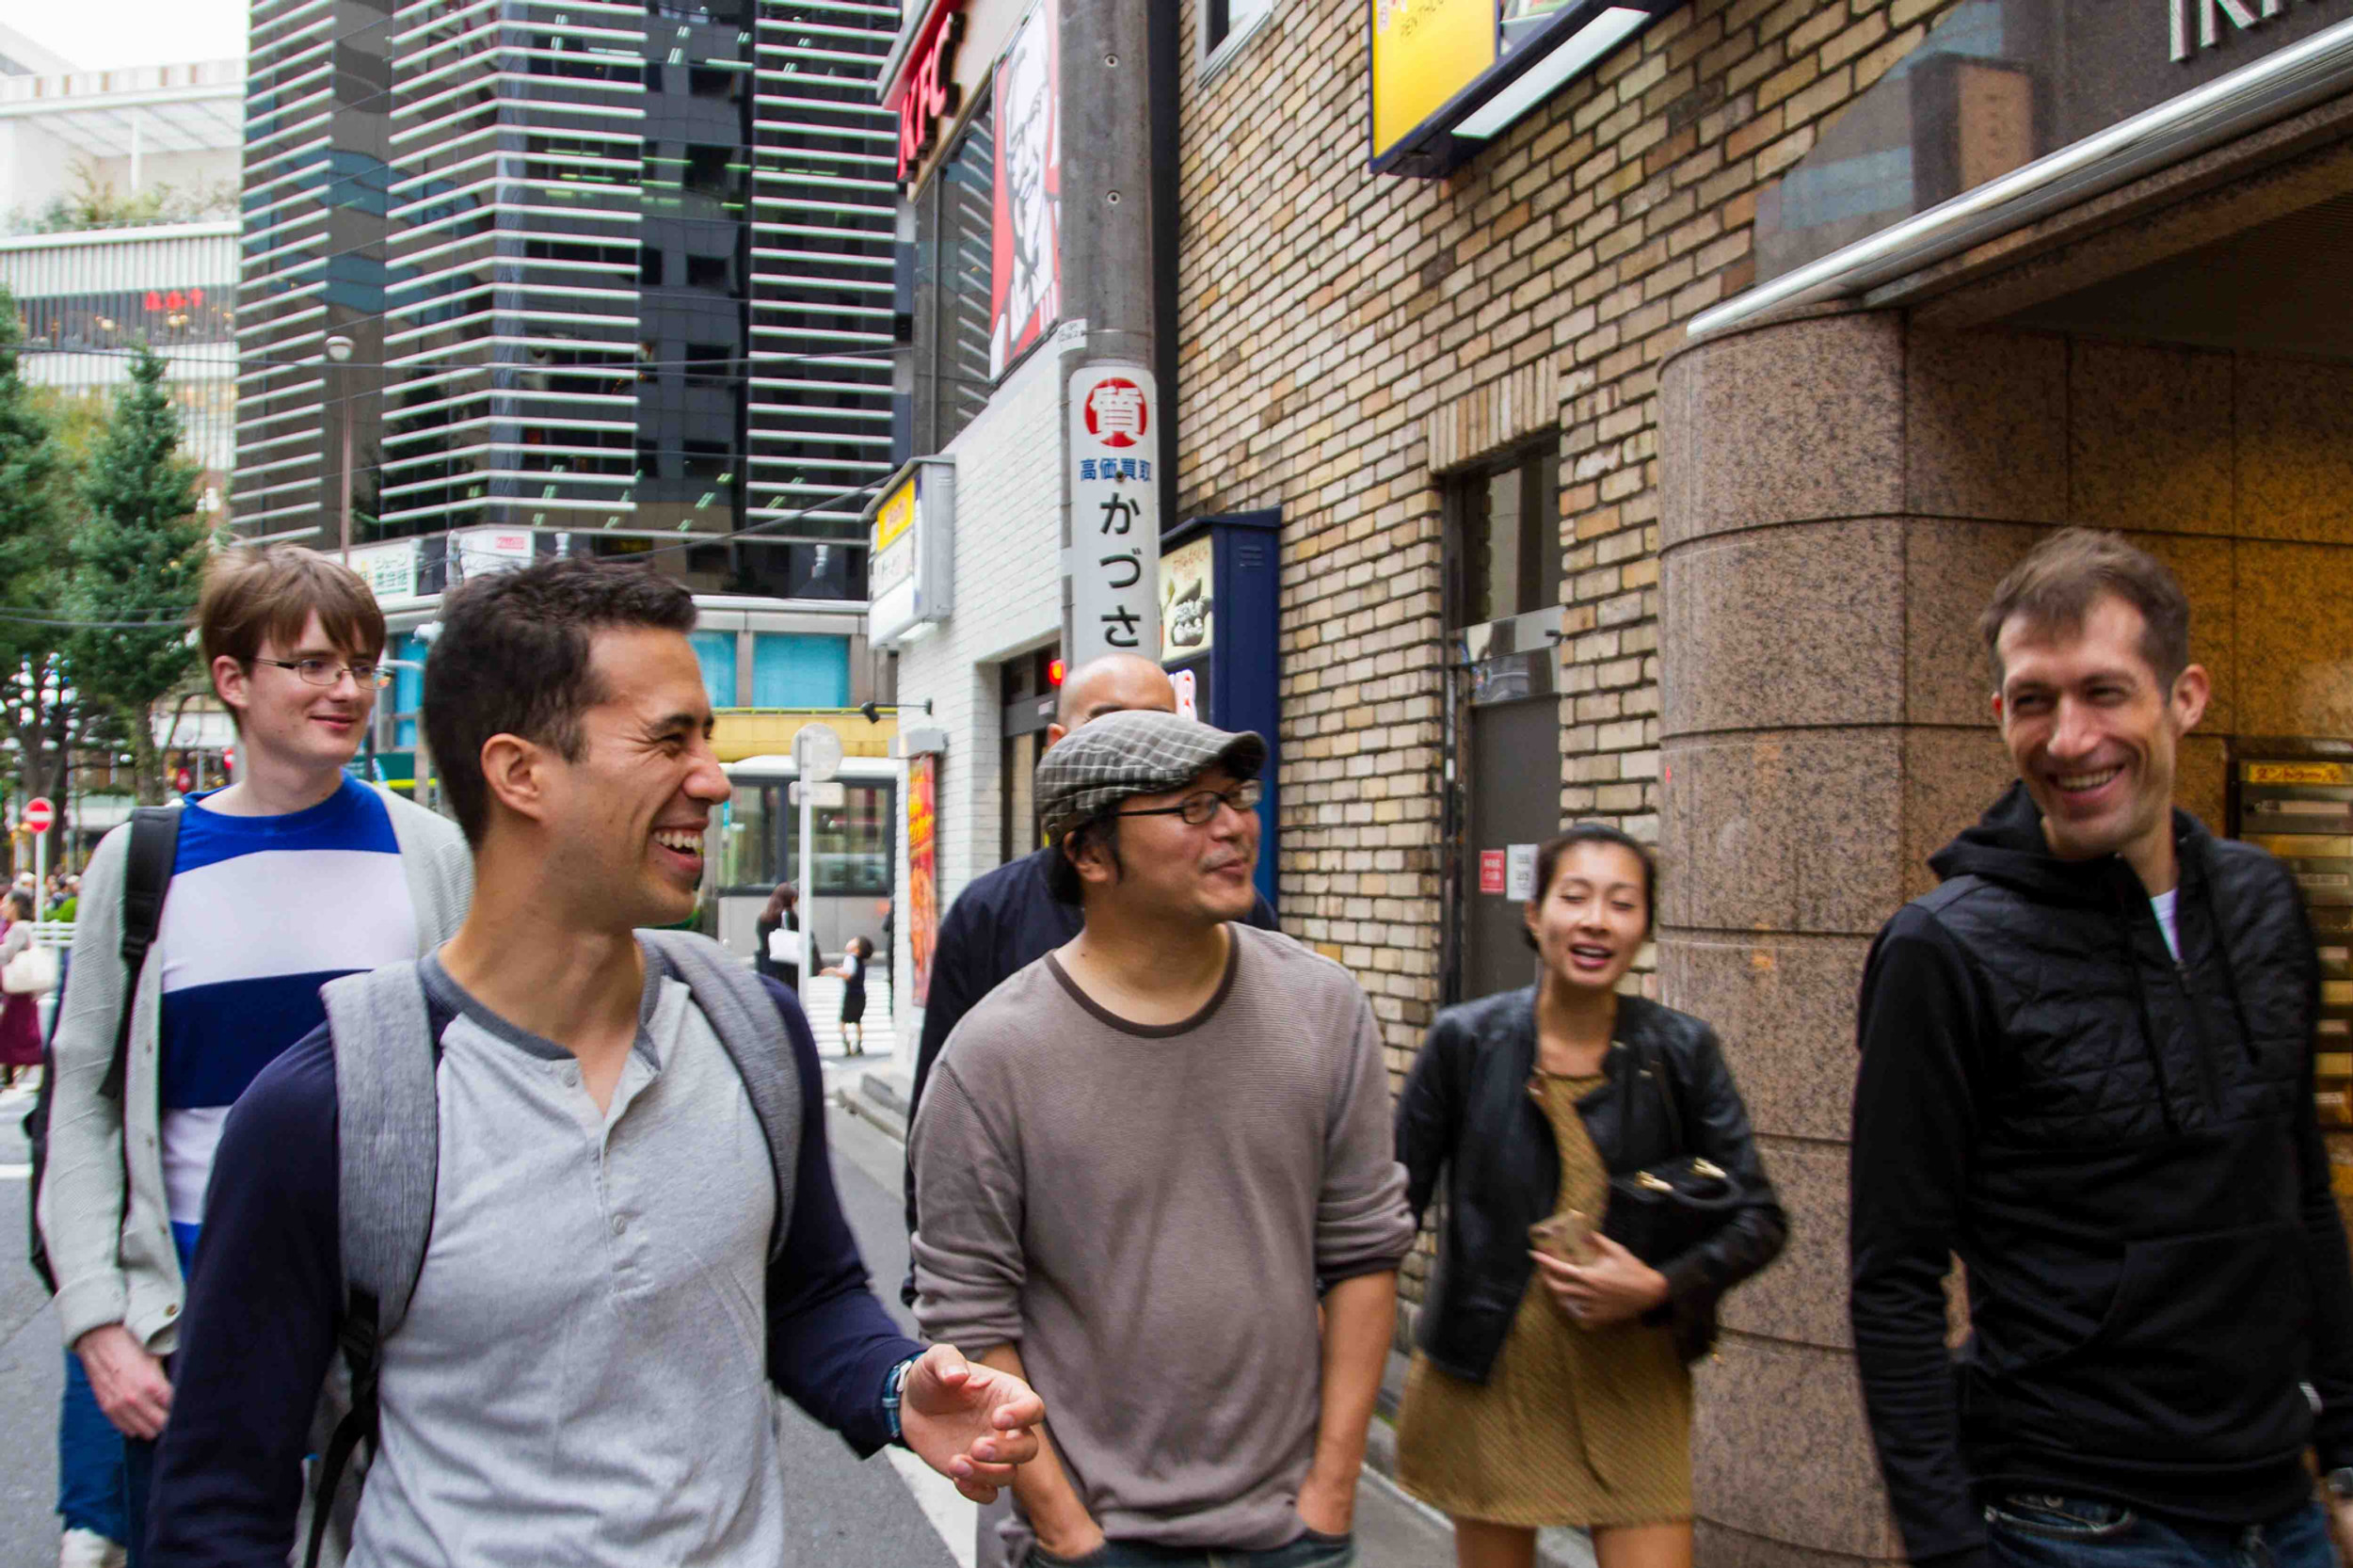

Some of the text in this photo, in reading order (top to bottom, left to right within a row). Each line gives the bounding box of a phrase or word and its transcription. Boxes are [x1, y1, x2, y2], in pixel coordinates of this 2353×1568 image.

[897, 11, 953, 181] KFC
[1089, 384, 1144, 444] 質
[1080, 457, 1152, 483] 高価買取
[1099, 491, 1142, 648] かづさ
